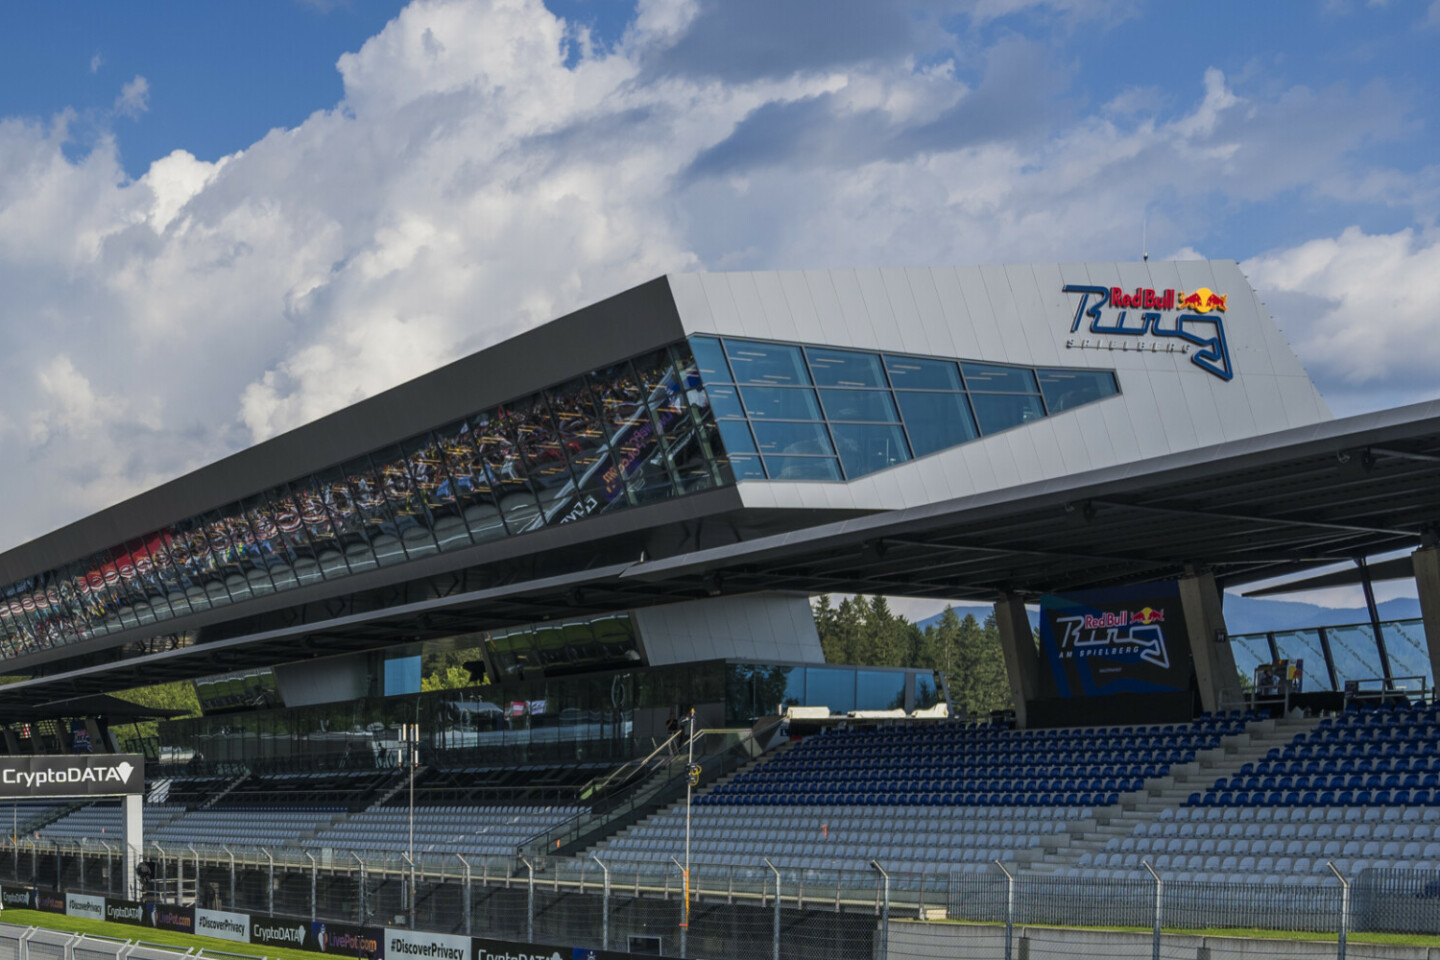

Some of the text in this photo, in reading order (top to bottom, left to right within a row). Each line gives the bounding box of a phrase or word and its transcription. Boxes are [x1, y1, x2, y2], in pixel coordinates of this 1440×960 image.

[1111, 287, 1175, 310] Red Bull
[1063, 284, 1233, 381] Ring
[1085, 610, 1128, 630] Red Bull
[1059, 646, 1140, 659] AM SPIELBERG
[3, 767, 118, 786] CryptoDATA
[107, 904, 138, 920] CryptoDATA
[199, 914, 245, 935] #DiscoverPrivacy
[254, 924, 300, 942] CryptoDATA
